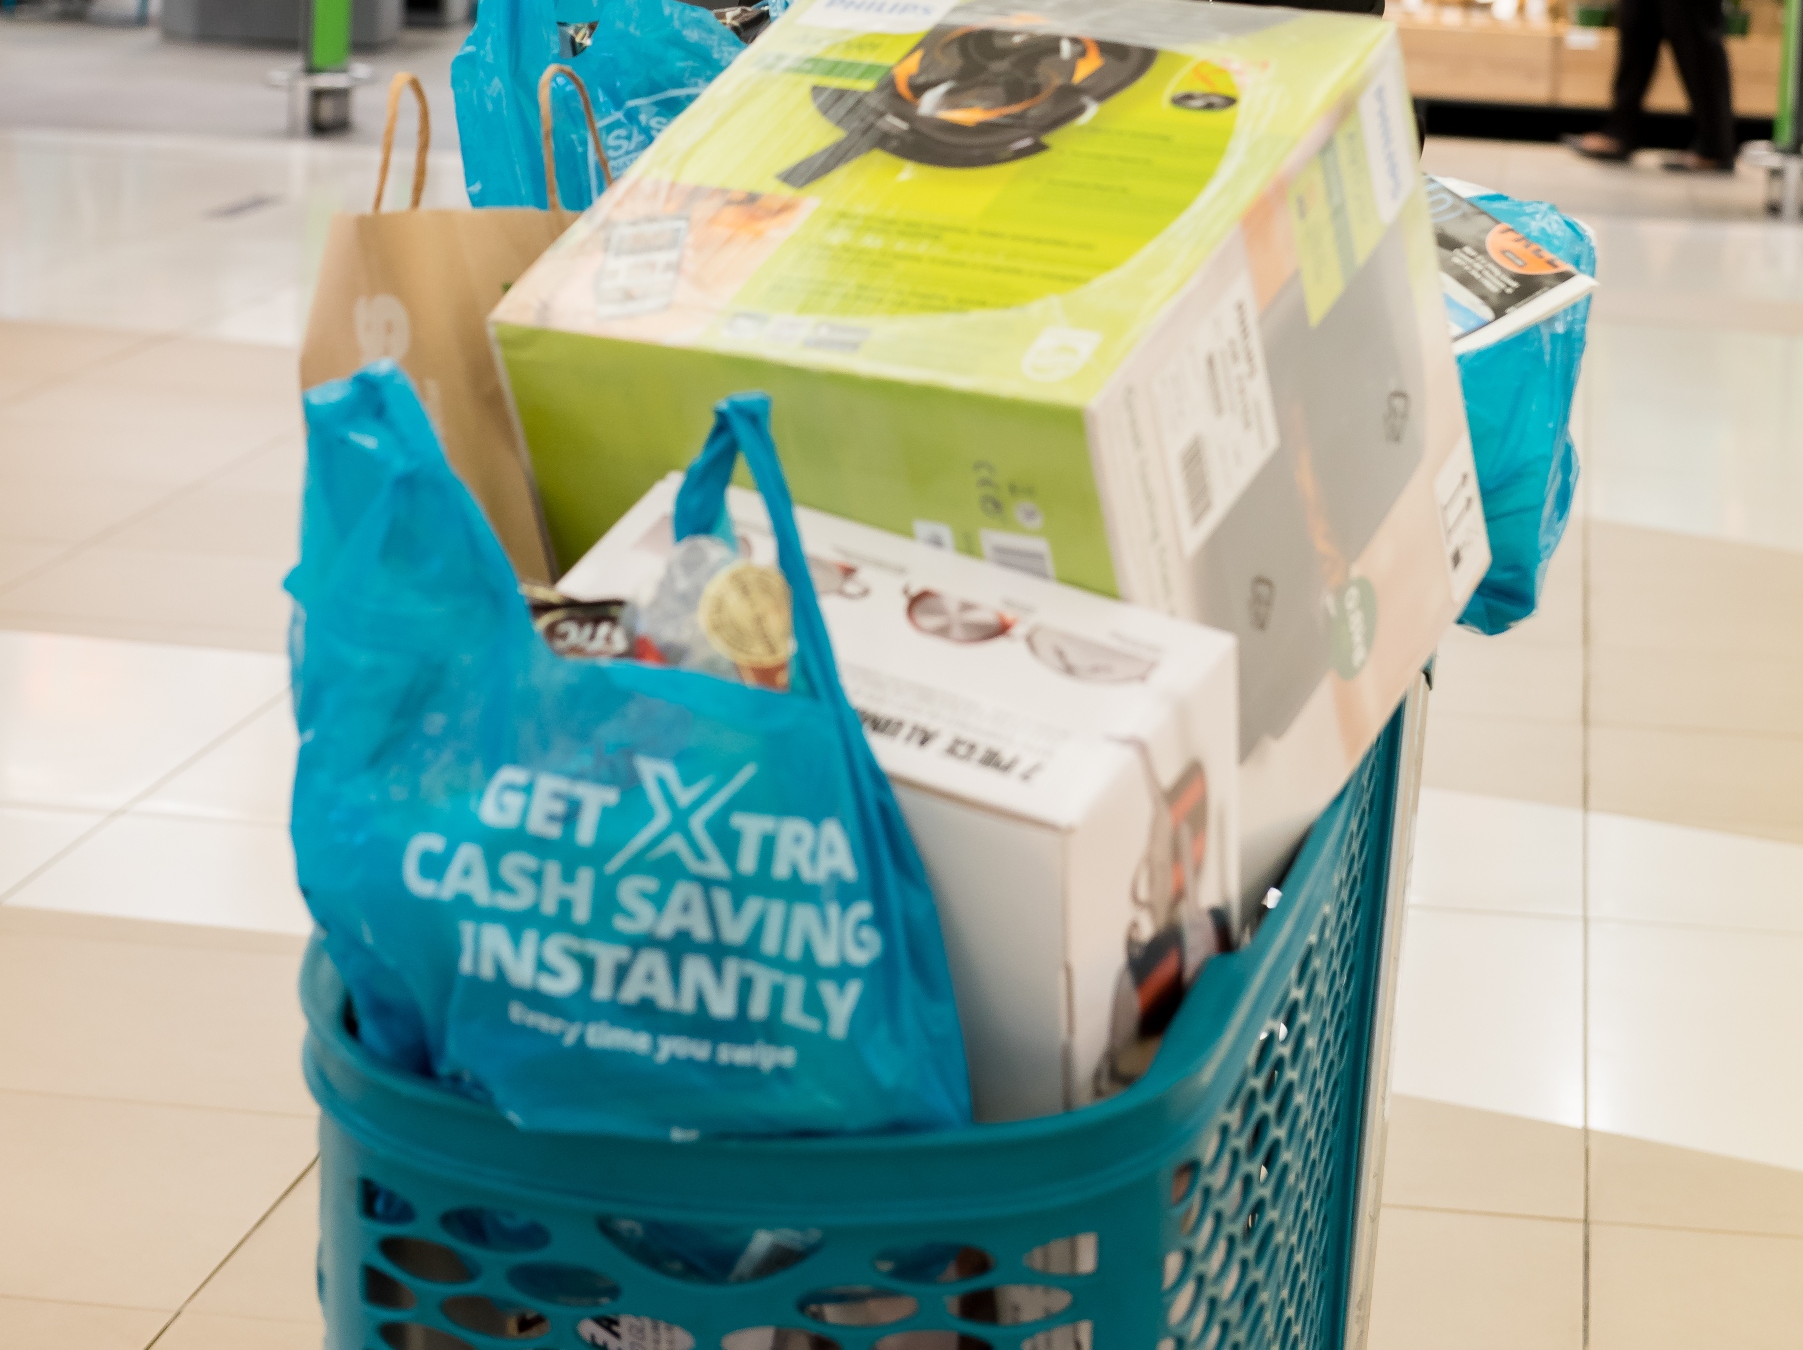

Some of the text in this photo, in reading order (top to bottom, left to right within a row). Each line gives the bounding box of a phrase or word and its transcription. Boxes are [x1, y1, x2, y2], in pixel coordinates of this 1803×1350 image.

[479, 763, 620, 847] GET
[402, 832, 882, 968] CASH SAVING
[458, 919, 864, 1041] INSTANTLY
[508, 1000, 797, 1074] Every time you swipe
